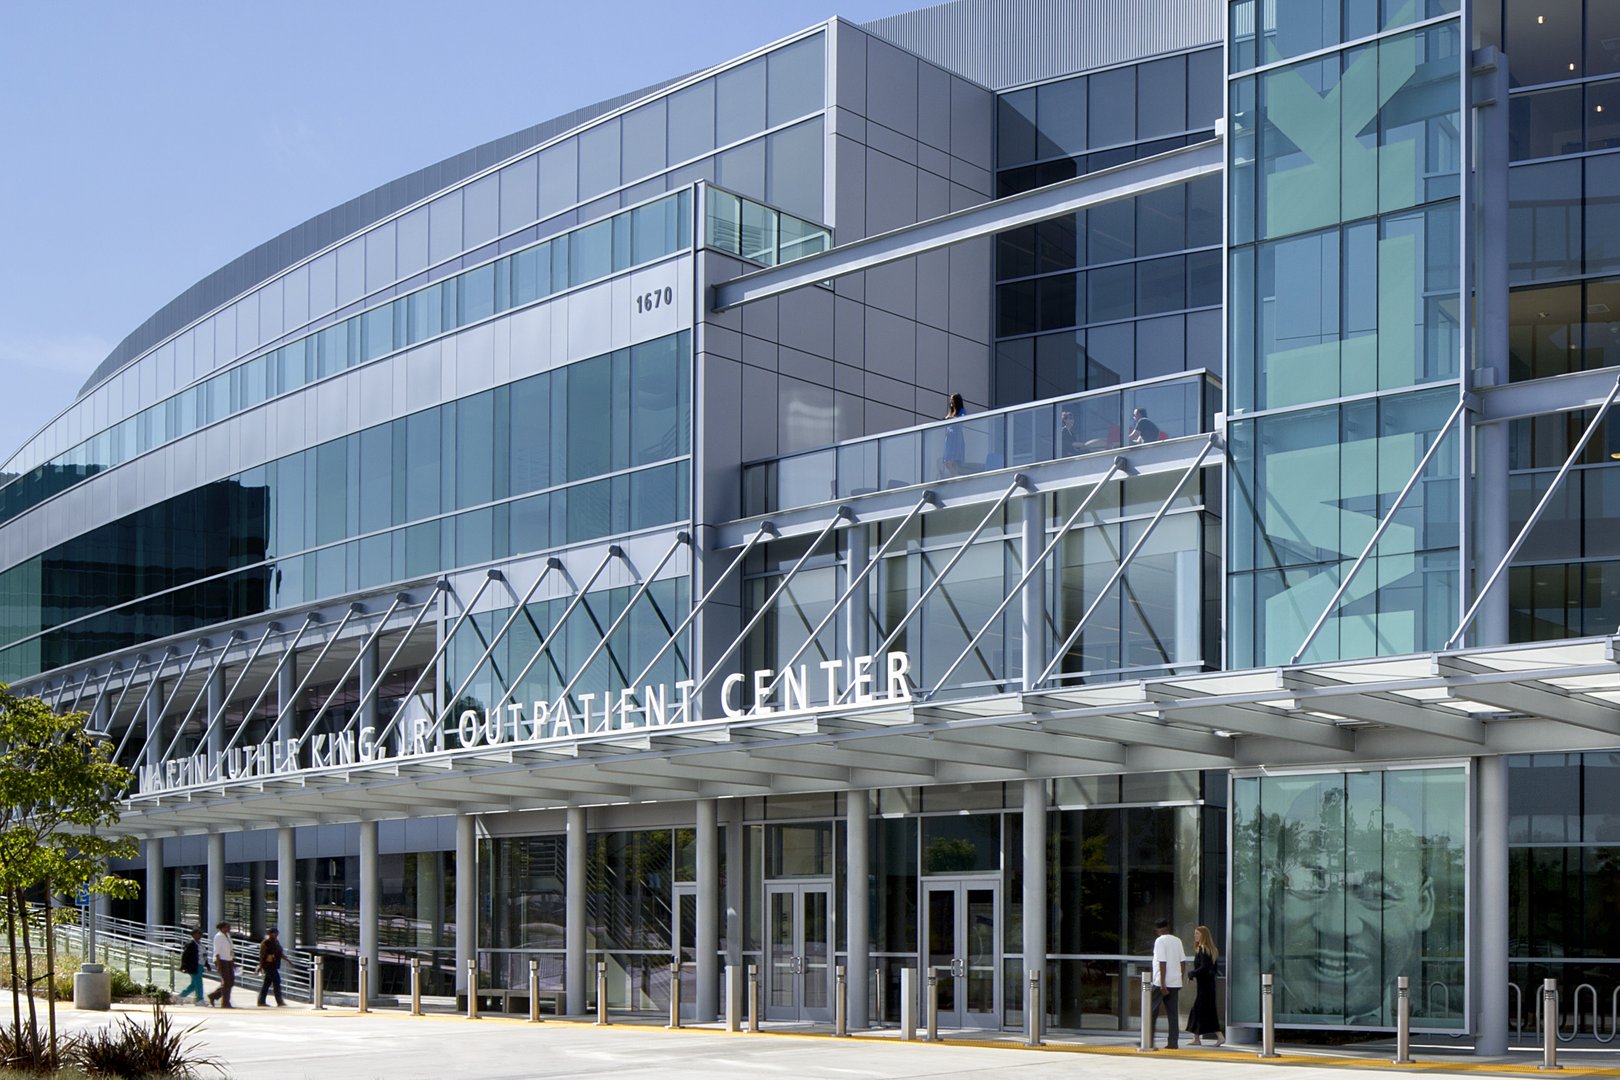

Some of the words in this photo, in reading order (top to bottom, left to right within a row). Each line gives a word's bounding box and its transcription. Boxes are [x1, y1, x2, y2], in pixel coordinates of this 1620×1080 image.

[636, 286, 673, 314] 1670
[139, 753, 206, 794] MARTIN
[216, 738, 301, 782] LUTHER
[312, 726, 387, 768] KING,
[398, 718, 441, 758] JR.
[458, 679, 695, 748] OUTPATIENT
[721, 651, 912, 717] CENTER
